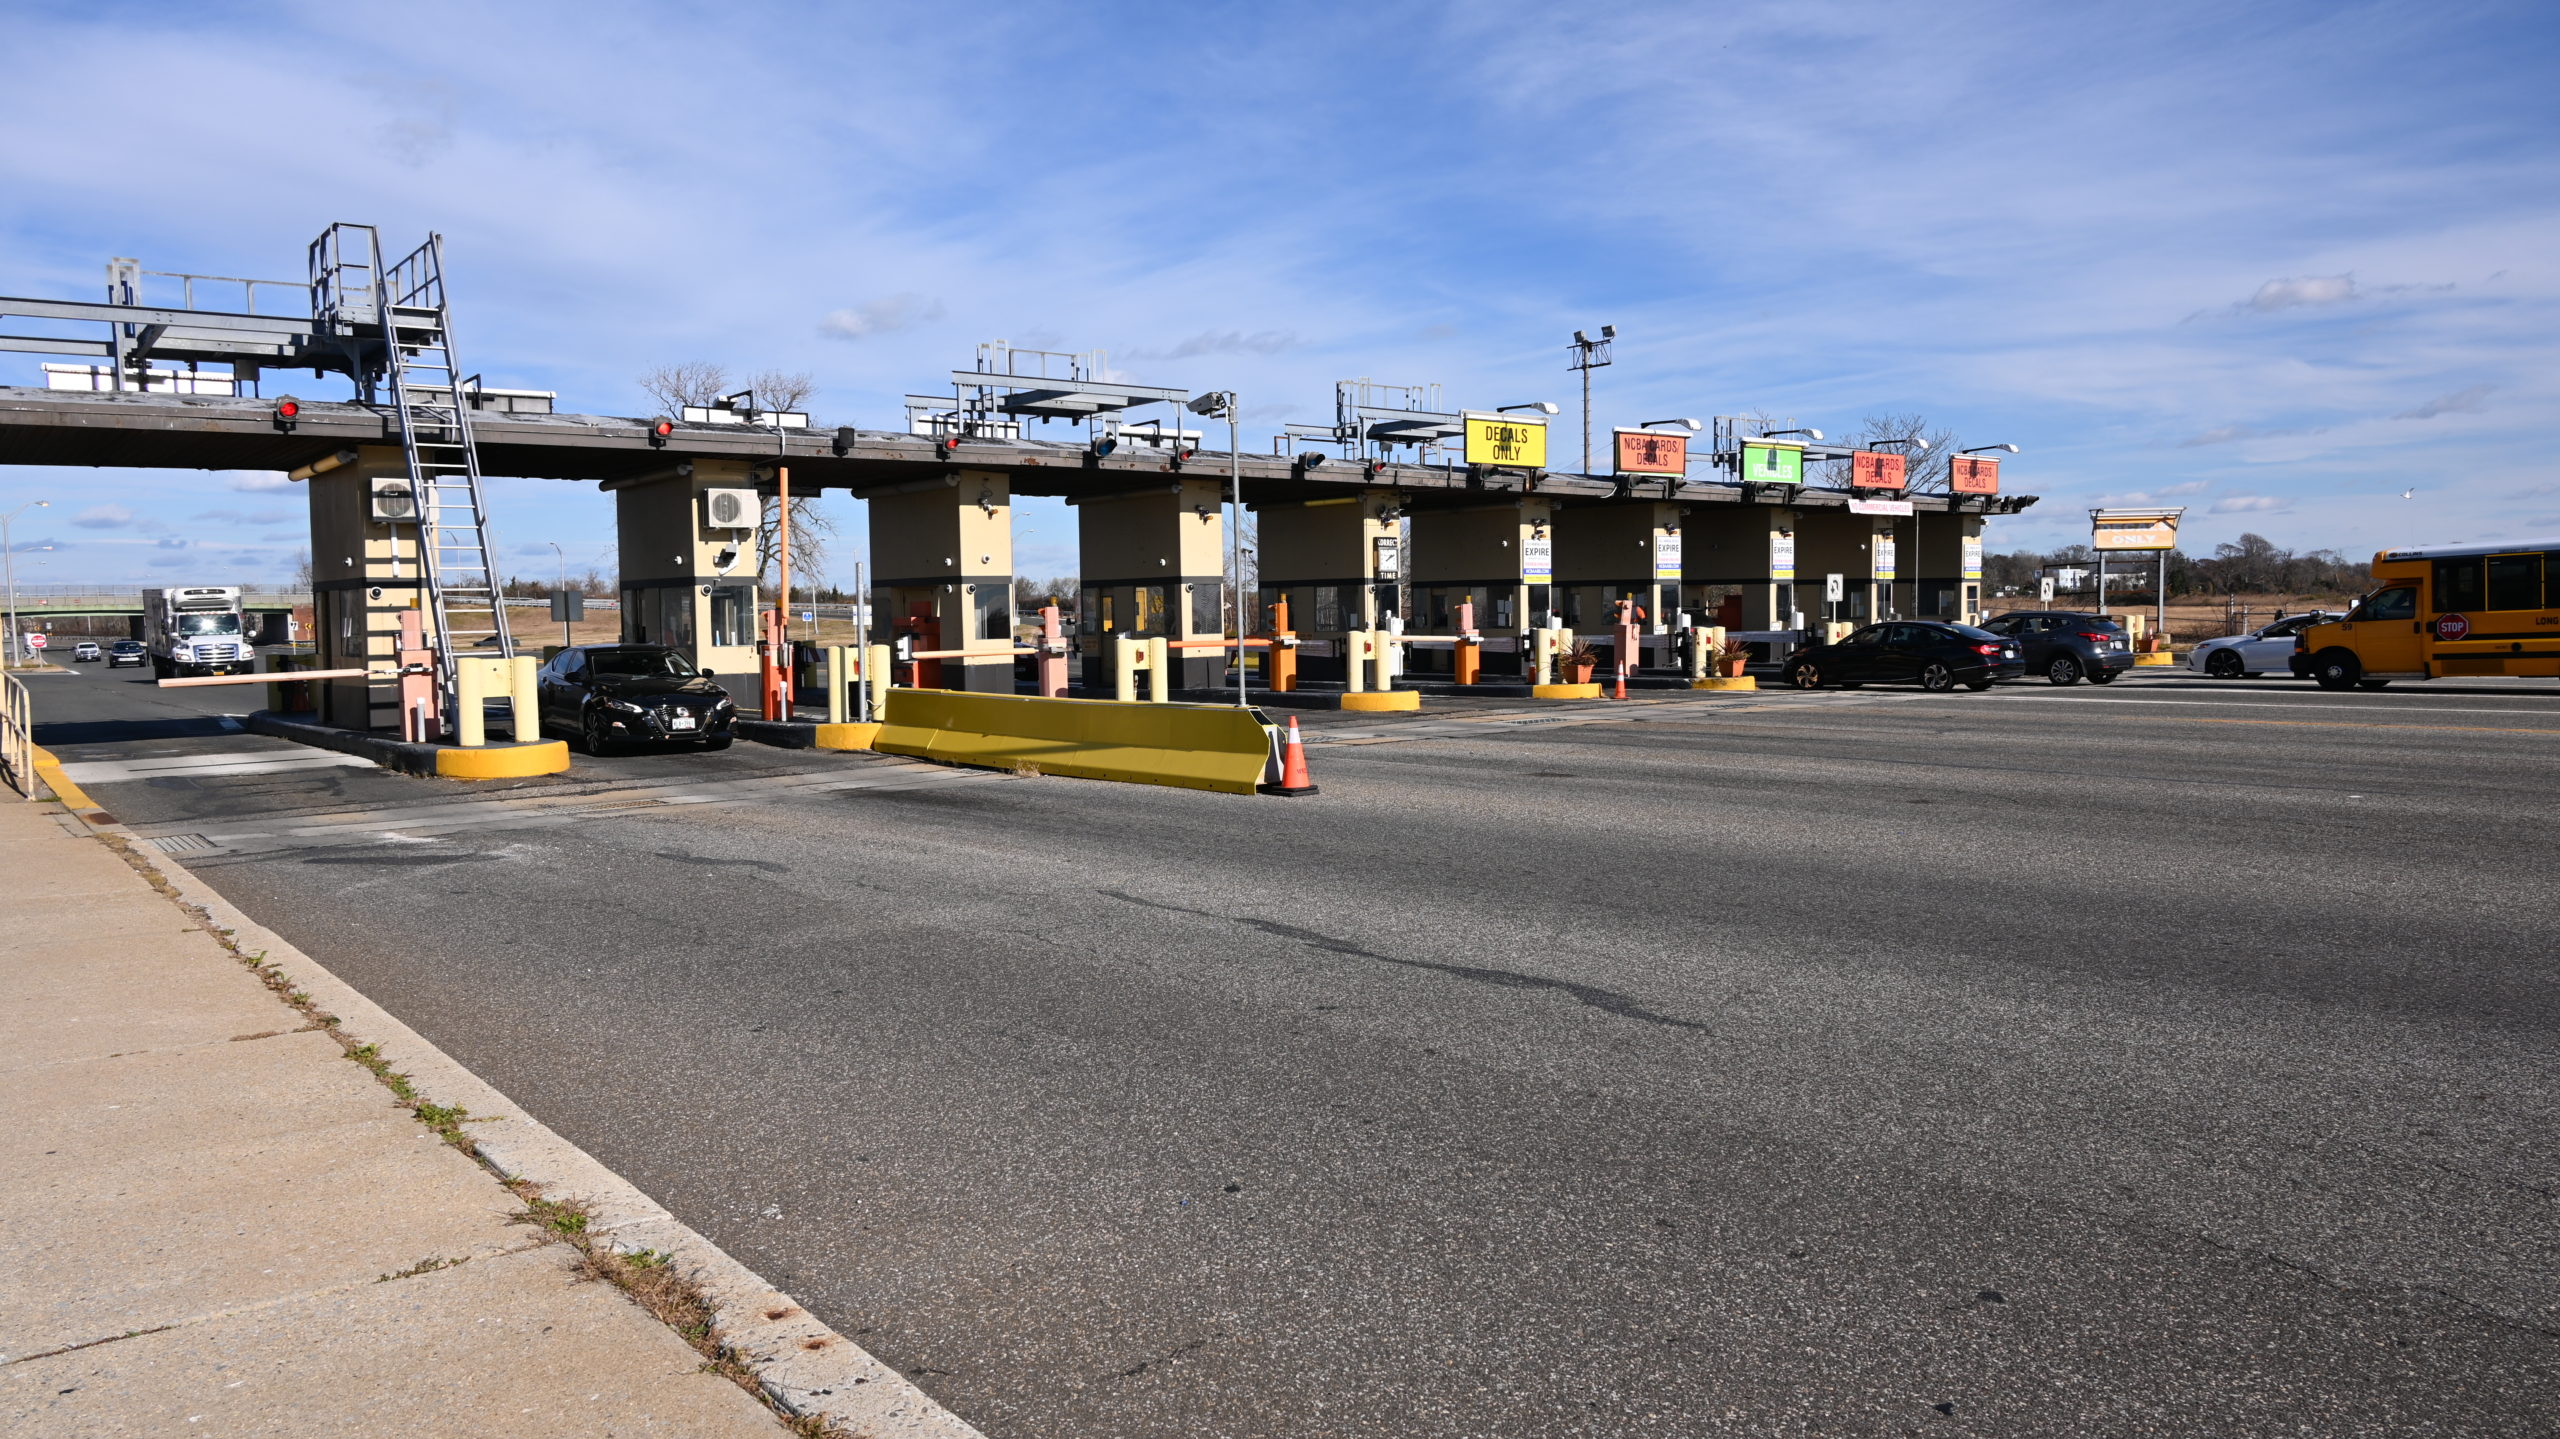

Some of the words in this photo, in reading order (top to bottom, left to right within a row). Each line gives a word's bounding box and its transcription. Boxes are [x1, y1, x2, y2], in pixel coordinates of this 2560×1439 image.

[1485, 425, 1528, 444] DECALS
[1624, 437, 1648, 451] NCBA
[1492, 444, 1521, 461] ONLY
[1636, 452, 1668, 466] DECALS
[1856, 455, 1875, 469] NCBA
[1752, 463, 1793, 479] VEHICLES
[1865, 470, 1892, 484] DECALS
[1964, 476, 1986, 489] DECALS
[1858, 503, 1888, 512] COMMERCIAL
[1889, 503, 1910, 513] VEHICLES
[2111, 535, 2157, 545] ONLY
[1525, 547, 1550, 557] EXPIRE
[1658, 544, 1680, 553] EXPIRE
[1773, 546, 1793, 554] EXPIRE
[1965, 550, 1981, 558] EXPIRE
[1380, 571, 1397, 580] TIME
[2535, 617, 2559, 626] LONG
[2341, 623, 2353, 632] 59
[2441, 621, 2465, 634] STOP
